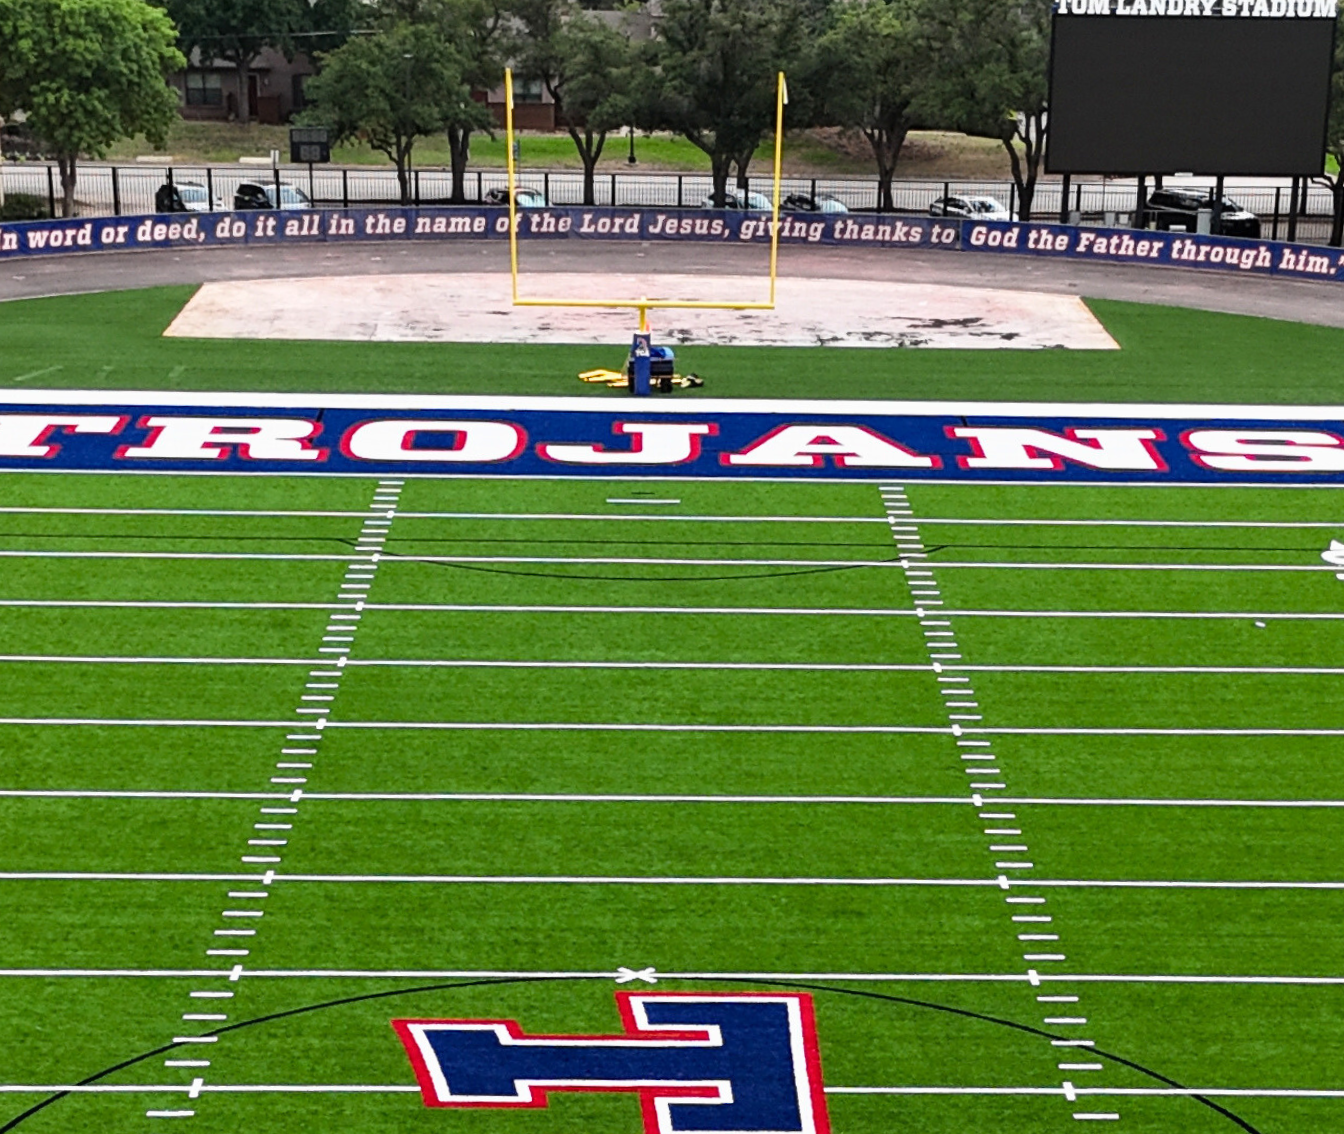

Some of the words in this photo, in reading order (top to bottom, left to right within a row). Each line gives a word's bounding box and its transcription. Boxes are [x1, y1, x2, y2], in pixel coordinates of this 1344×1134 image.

[1055, 0, 1111, 16] TOM
[1116, 0, 1212, 16] LANDRY
[1221, 0, 1338, 18] STADIUM
[27, 224, 91, 248] word
[101, 226, 127, 243] or
[137, 219, 205, 243] deed,
[216, 217, 245, 237] do
[255, 216, 275, 236] it
[285, 215, 319, 235] all
[328, 214, 354, 235] in
[364, 213, 405, 234] the
[415, 217, 485, 233] name
[495, 213, 525, 234] of
[530, 213, 572, 234] the
[580, 213, 639, 235] Lord
[649, 214, 730, 238] Jesus,
[740, 216, 824, 242] giving
[834, 220, 921, 242] thanks
[930, 224, 955, 244] to
[971, 227, 1017, 248] God
[1028, 229, 1069, 251] the
[1077, 232, 1164, 259] Father
[1171, 240, 1271, 269] through
